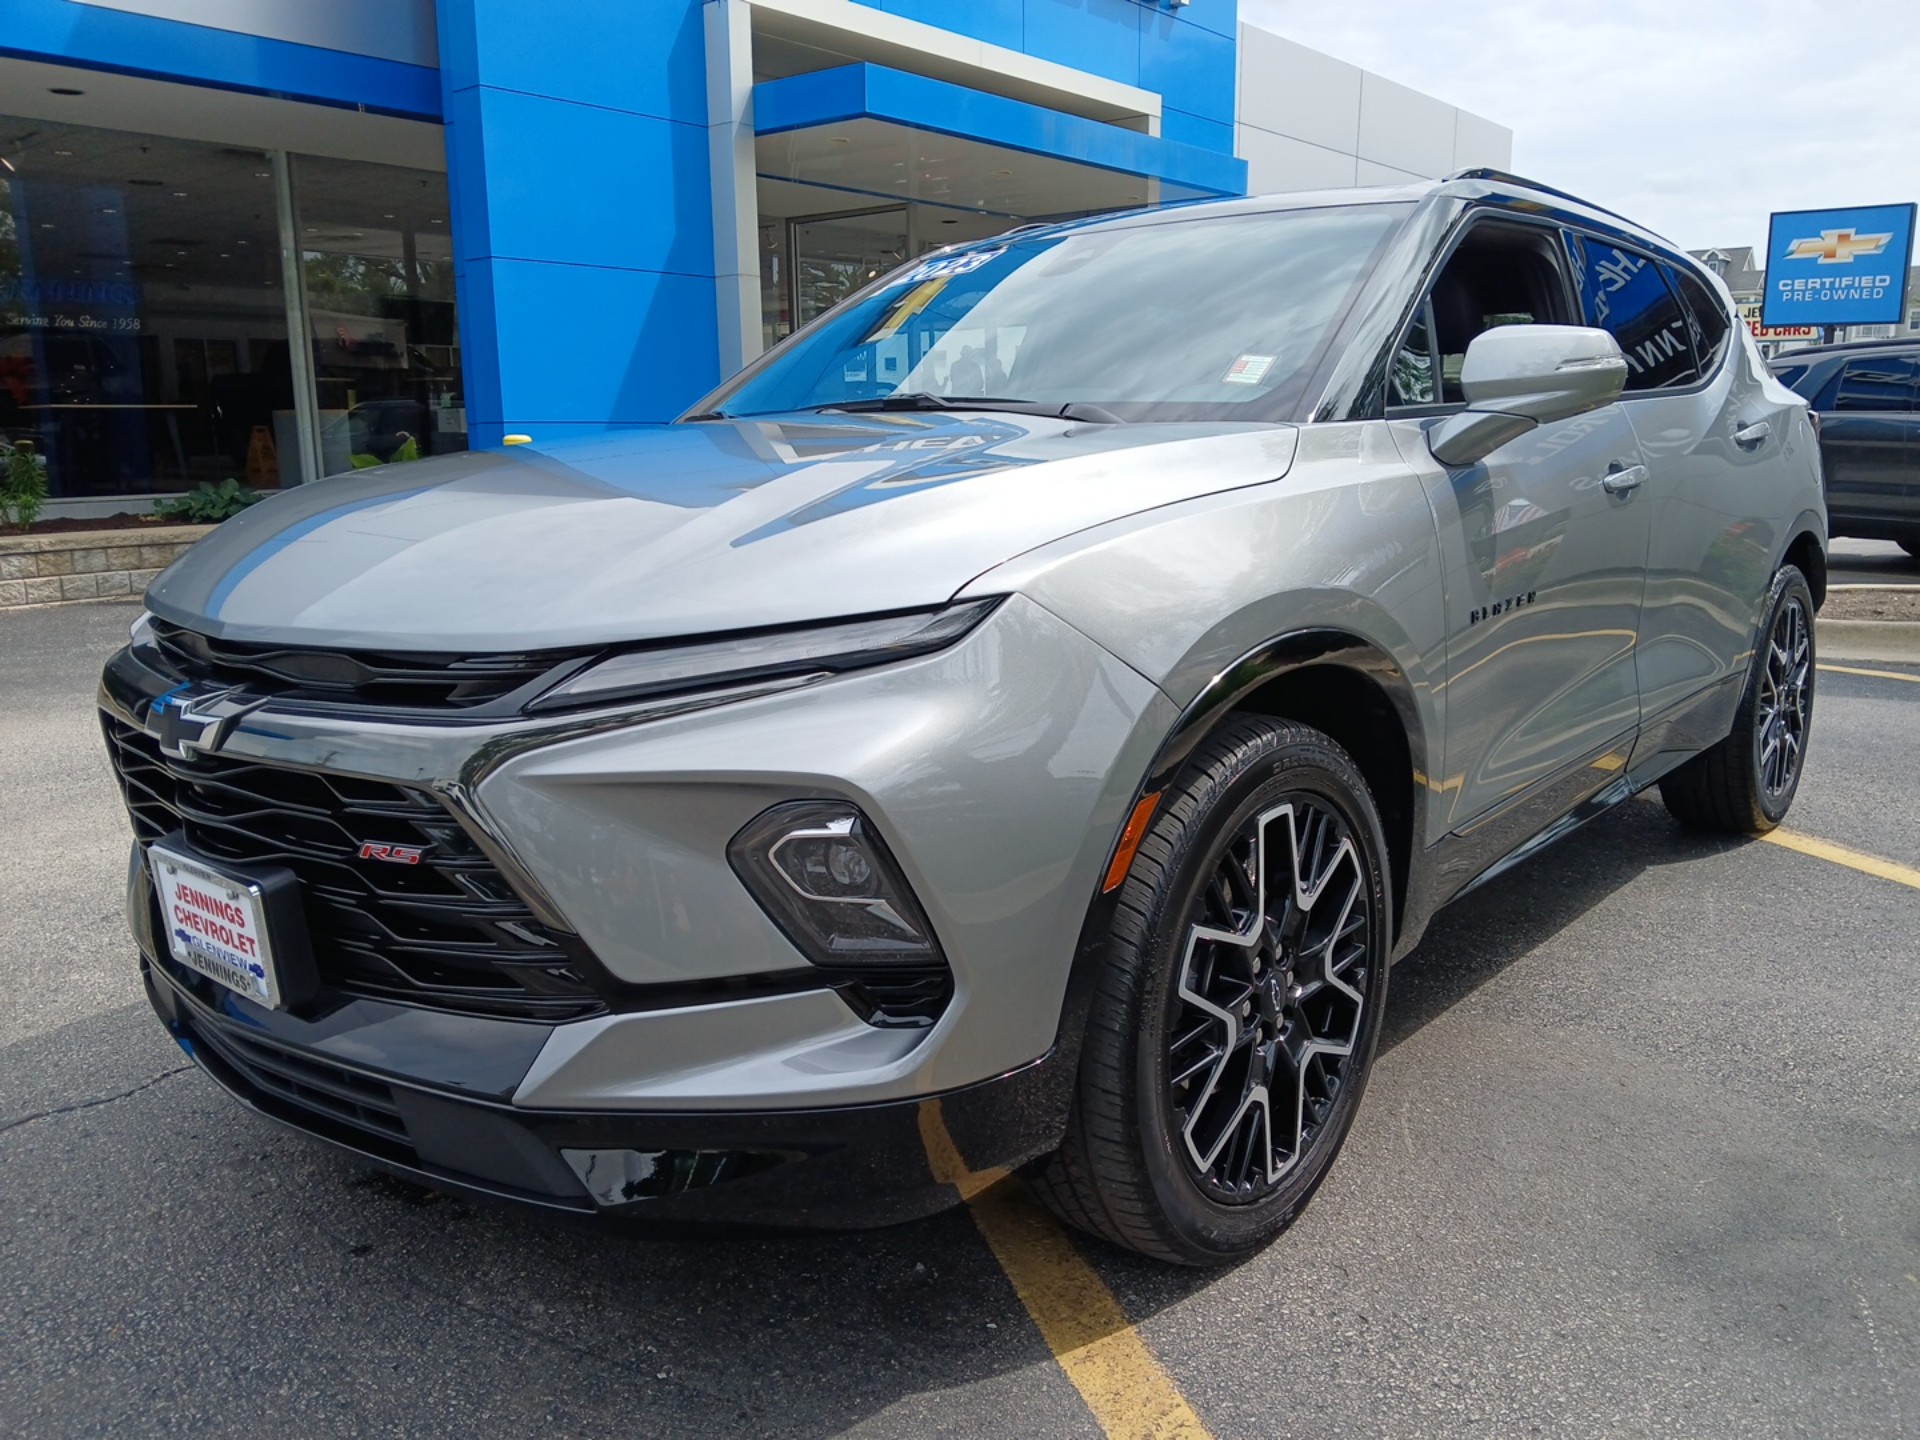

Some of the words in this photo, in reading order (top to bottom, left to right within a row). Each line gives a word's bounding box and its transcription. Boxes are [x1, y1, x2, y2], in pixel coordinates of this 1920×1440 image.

[1778, 274, 1891, 291] CERTIFIED
[1782, 287, 1884, 302] PRE-OWNED
[6, 312, 49, 328] Serving
[53, 314, 75, 328] You
[78, 314, 108, 329] Since
[112, 317, 141, 330] 1958
[1470, 590, 1537, 625] BLAZER
[359, 843, 421, 865] RS
[174, 882, 246, 929] JENNINGS
[173, 904, 256, 958] CHEVROLET
[190, 935, 249, 971] GLENVIEW
